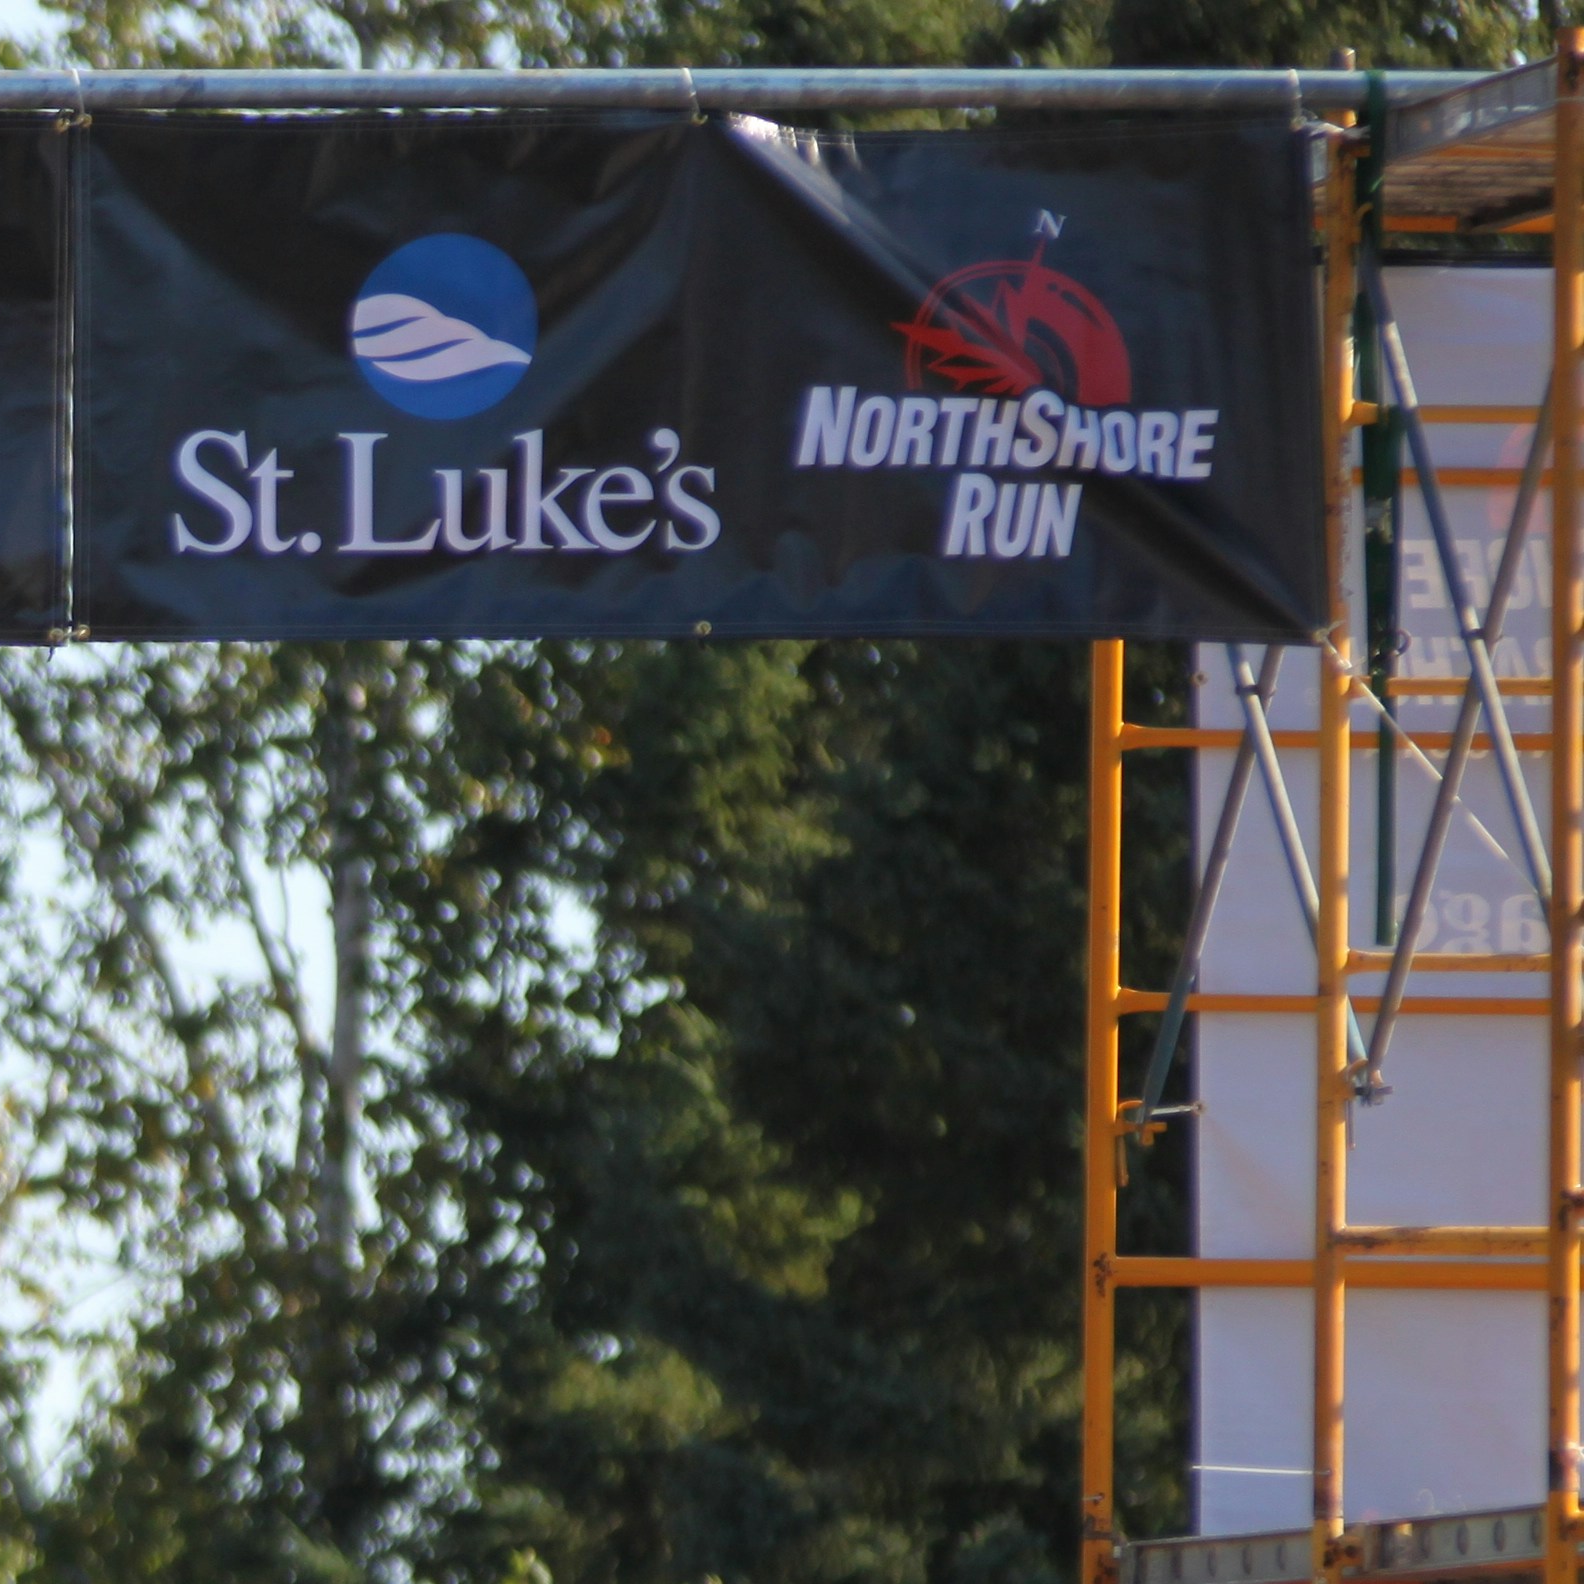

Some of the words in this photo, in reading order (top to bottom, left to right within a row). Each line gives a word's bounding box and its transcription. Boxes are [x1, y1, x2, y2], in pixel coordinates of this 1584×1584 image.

[1034, 209, 1068, 240] N
[795, 385, 1220, 480] NORTHSHORE
[174, 428, 322, 555] St.
[337, 427, 722, 553] Luke’s
[944, 473, 1082, 559] RUN
